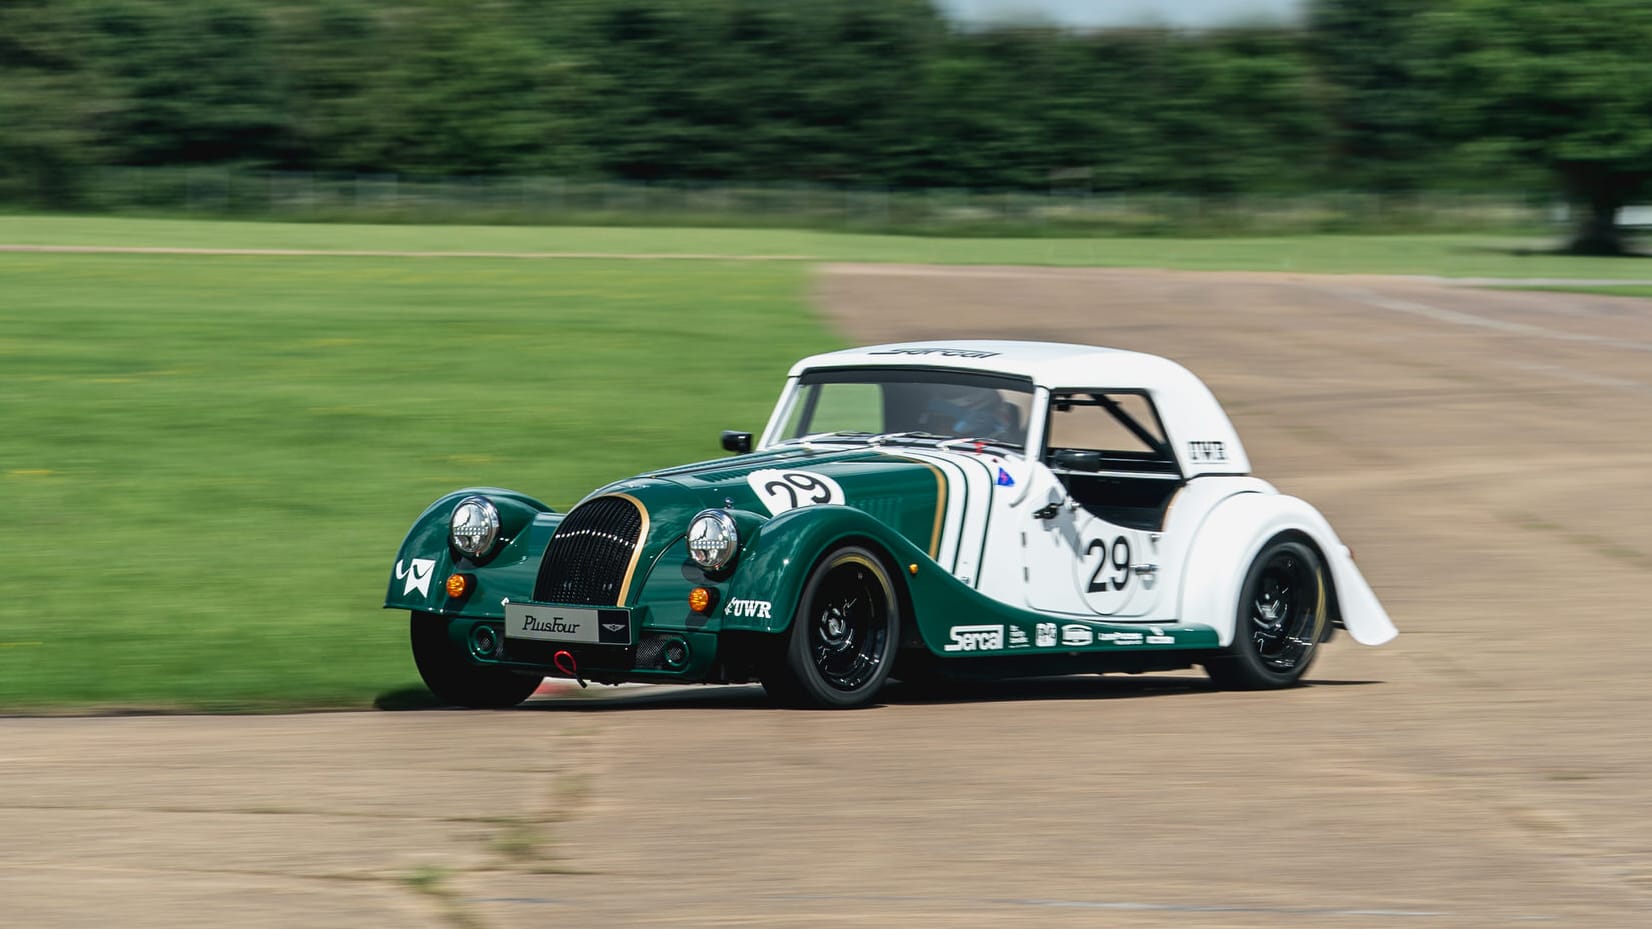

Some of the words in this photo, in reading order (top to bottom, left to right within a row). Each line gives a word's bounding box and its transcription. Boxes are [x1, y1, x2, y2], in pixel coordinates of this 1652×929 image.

[765, 474, 832, 509] 29
[1084, 535, 1131, 593] 29
[733, 599, 772, 619] UWR
[944, 624, 1004, 651] Sercal
